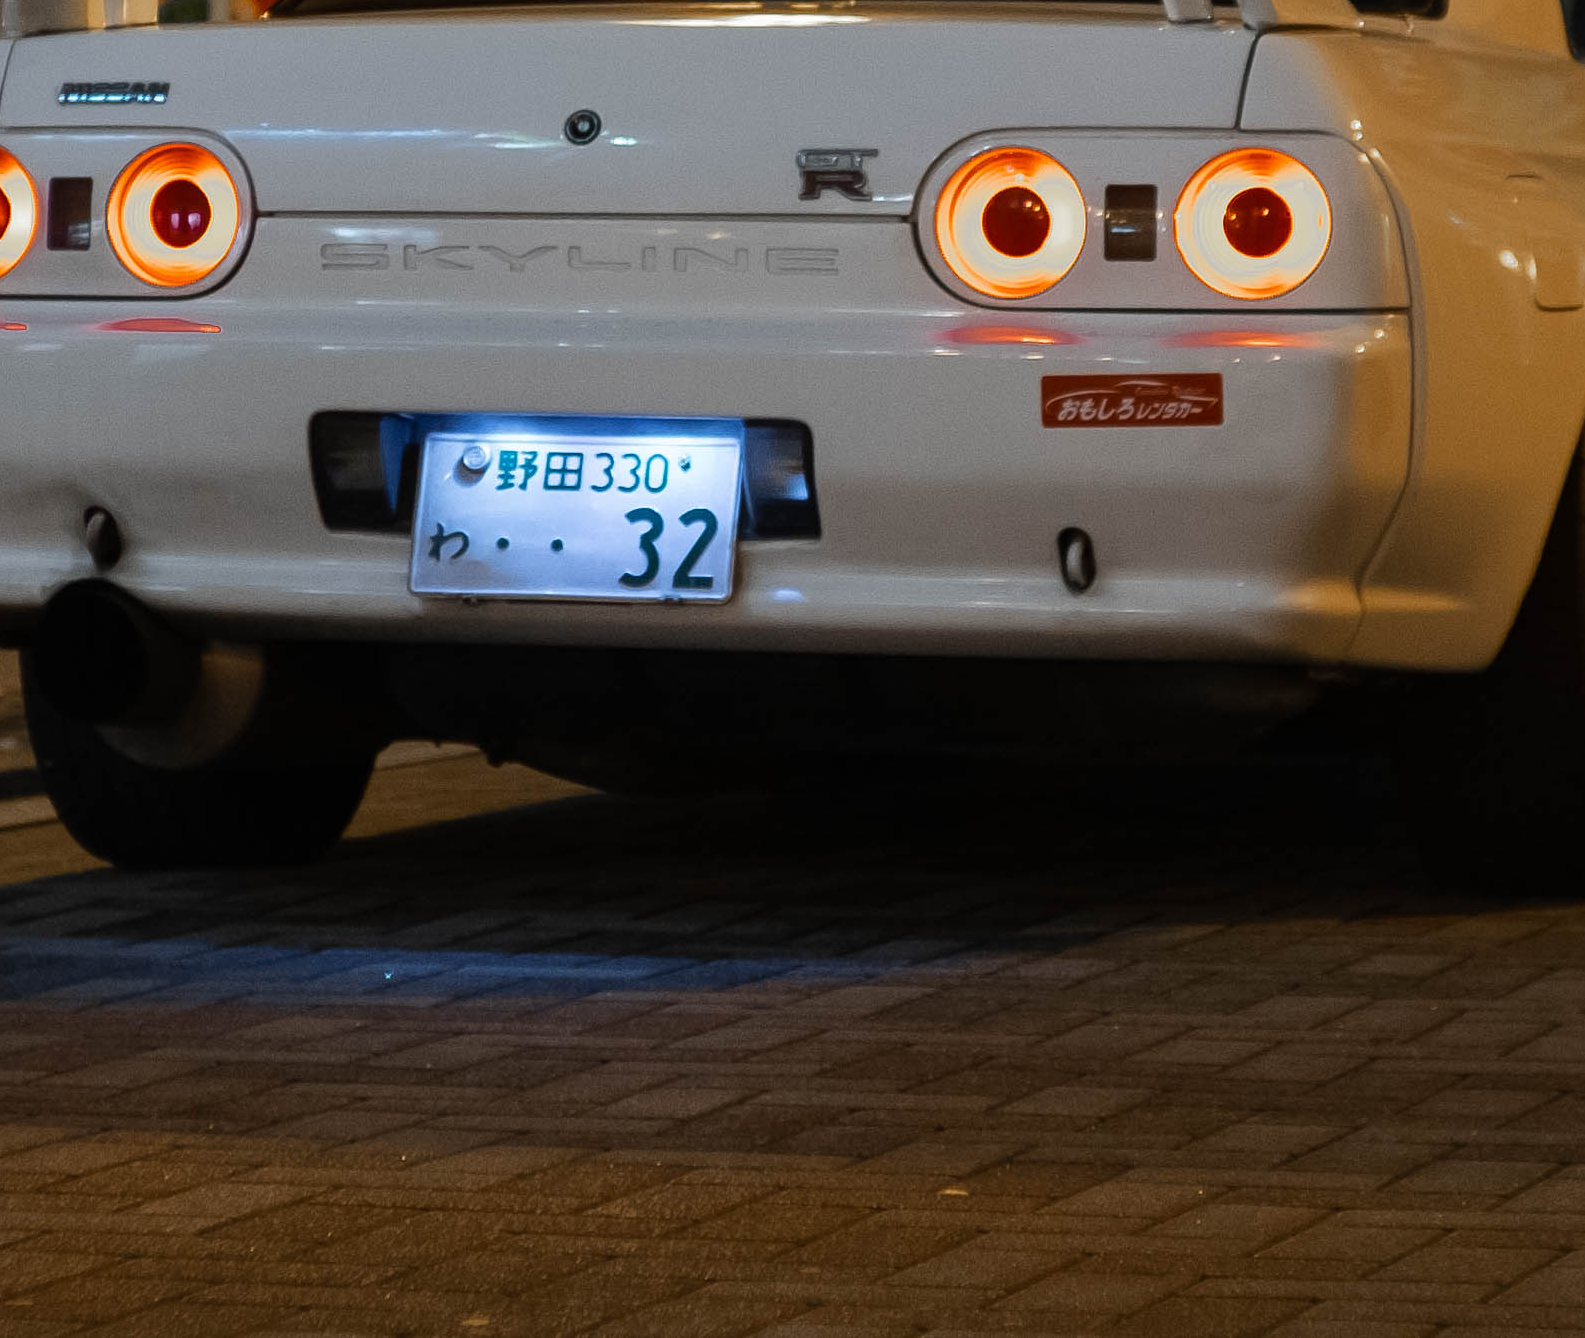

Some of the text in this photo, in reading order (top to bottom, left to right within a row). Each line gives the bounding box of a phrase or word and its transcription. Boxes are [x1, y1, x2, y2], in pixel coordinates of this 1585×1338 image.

[59, 82, 171, 104] NISSAN
[319, 242, 840, 273] SKYLINE
[1057, 397, 1204, 422] おもしろレンタカー
[617, 507, 719, 590] 32
